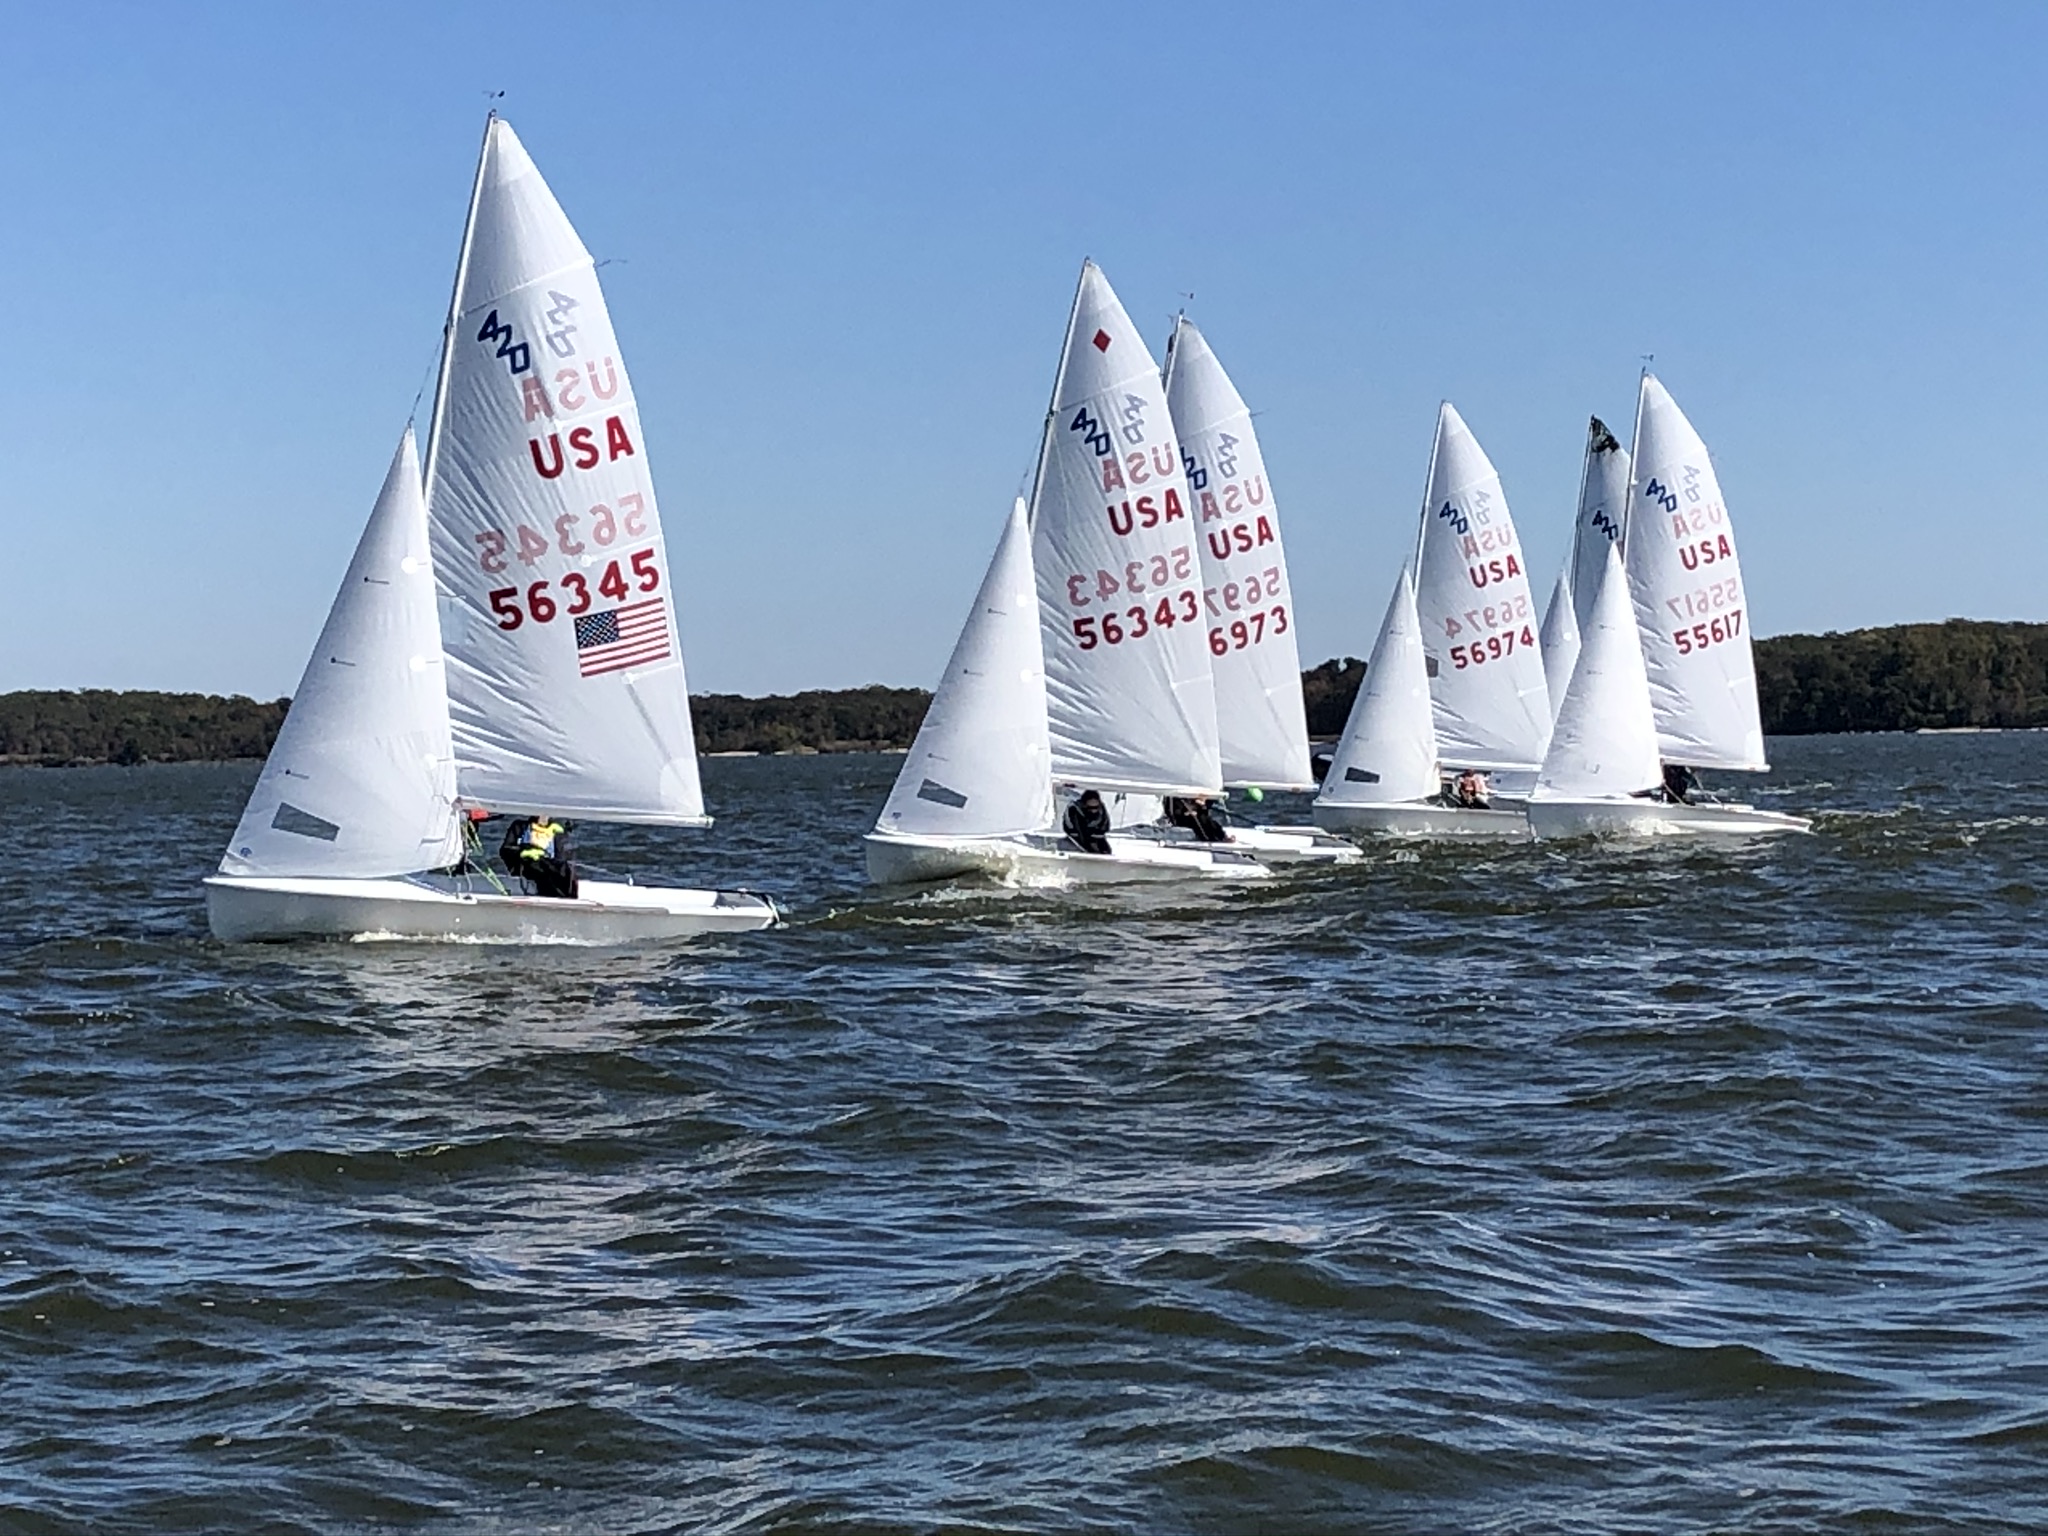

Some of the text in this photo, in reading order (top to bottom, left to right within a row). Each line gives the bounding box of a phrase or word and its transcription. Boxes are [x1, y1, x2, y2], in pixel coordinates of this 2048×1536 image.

[477, 309, 530, 375] 420
[529, 416, 634, 479] USA
[1070, 407, 1110, 456] 420
[1107, 488, 1184, 536] USA
[1439, 501, 1468, 534] 420
[1645, 478, 1677, 513] 420
[1208, 515, 1274, 560] USA
[1679, 534, 1731, 571] USA
[489, 548, 660, 631] 56345
[1469, 554, 1521, 588] USA
[1073, 590, 1198, 650] 56343
[1209, 605, 1287, 656] 6973
[1673, 609, 1742, 655] 55617
[1450, 624, 1535, 670] 56974
